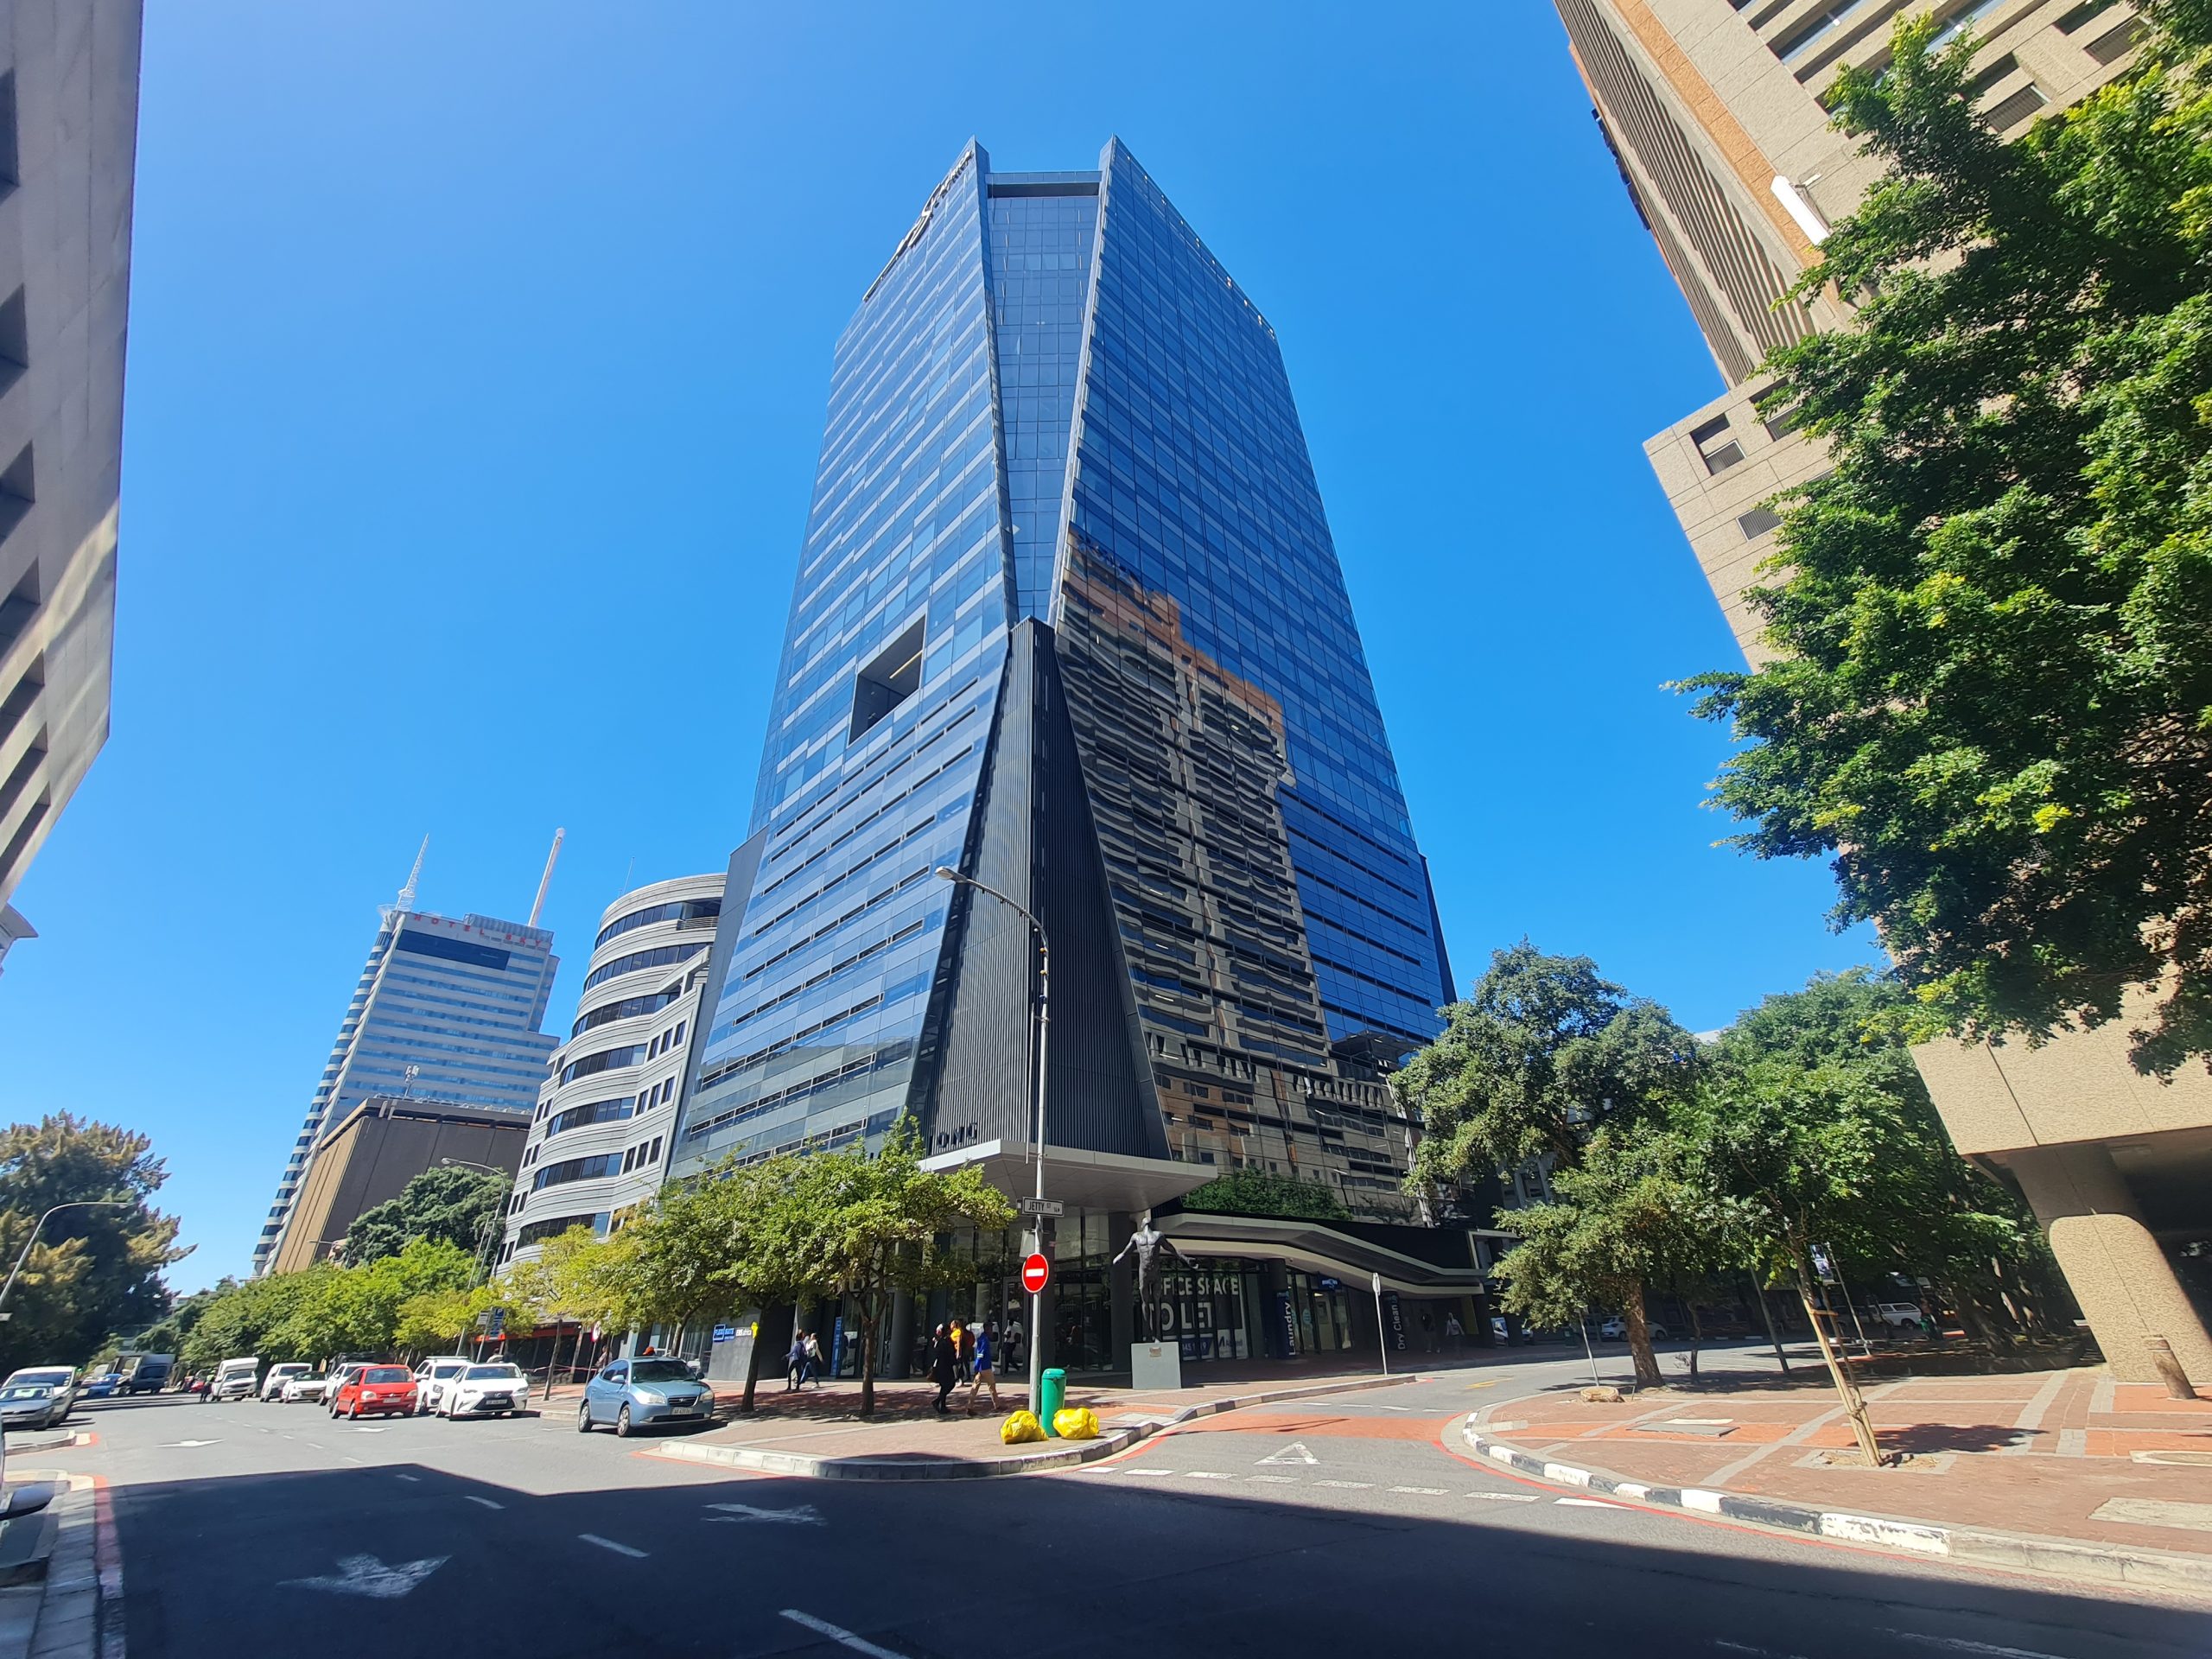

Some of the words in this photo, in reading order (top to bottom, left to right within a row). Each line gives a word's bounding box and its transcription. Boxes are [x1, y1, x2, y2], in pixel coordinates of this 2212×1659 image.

[414, 914, 486, 936] HOTEL
[505, 933, 541, 947] SKY
[1028, 1201, 1045, 1211] JETTY
[1149, 1276, 1193, 1296] FICE
[1284, 1301, 1296, 1356] Laundry
[1391, 1304, 1402, 1331] Clean
[1397, 1332, 1406, 1350] Dry
